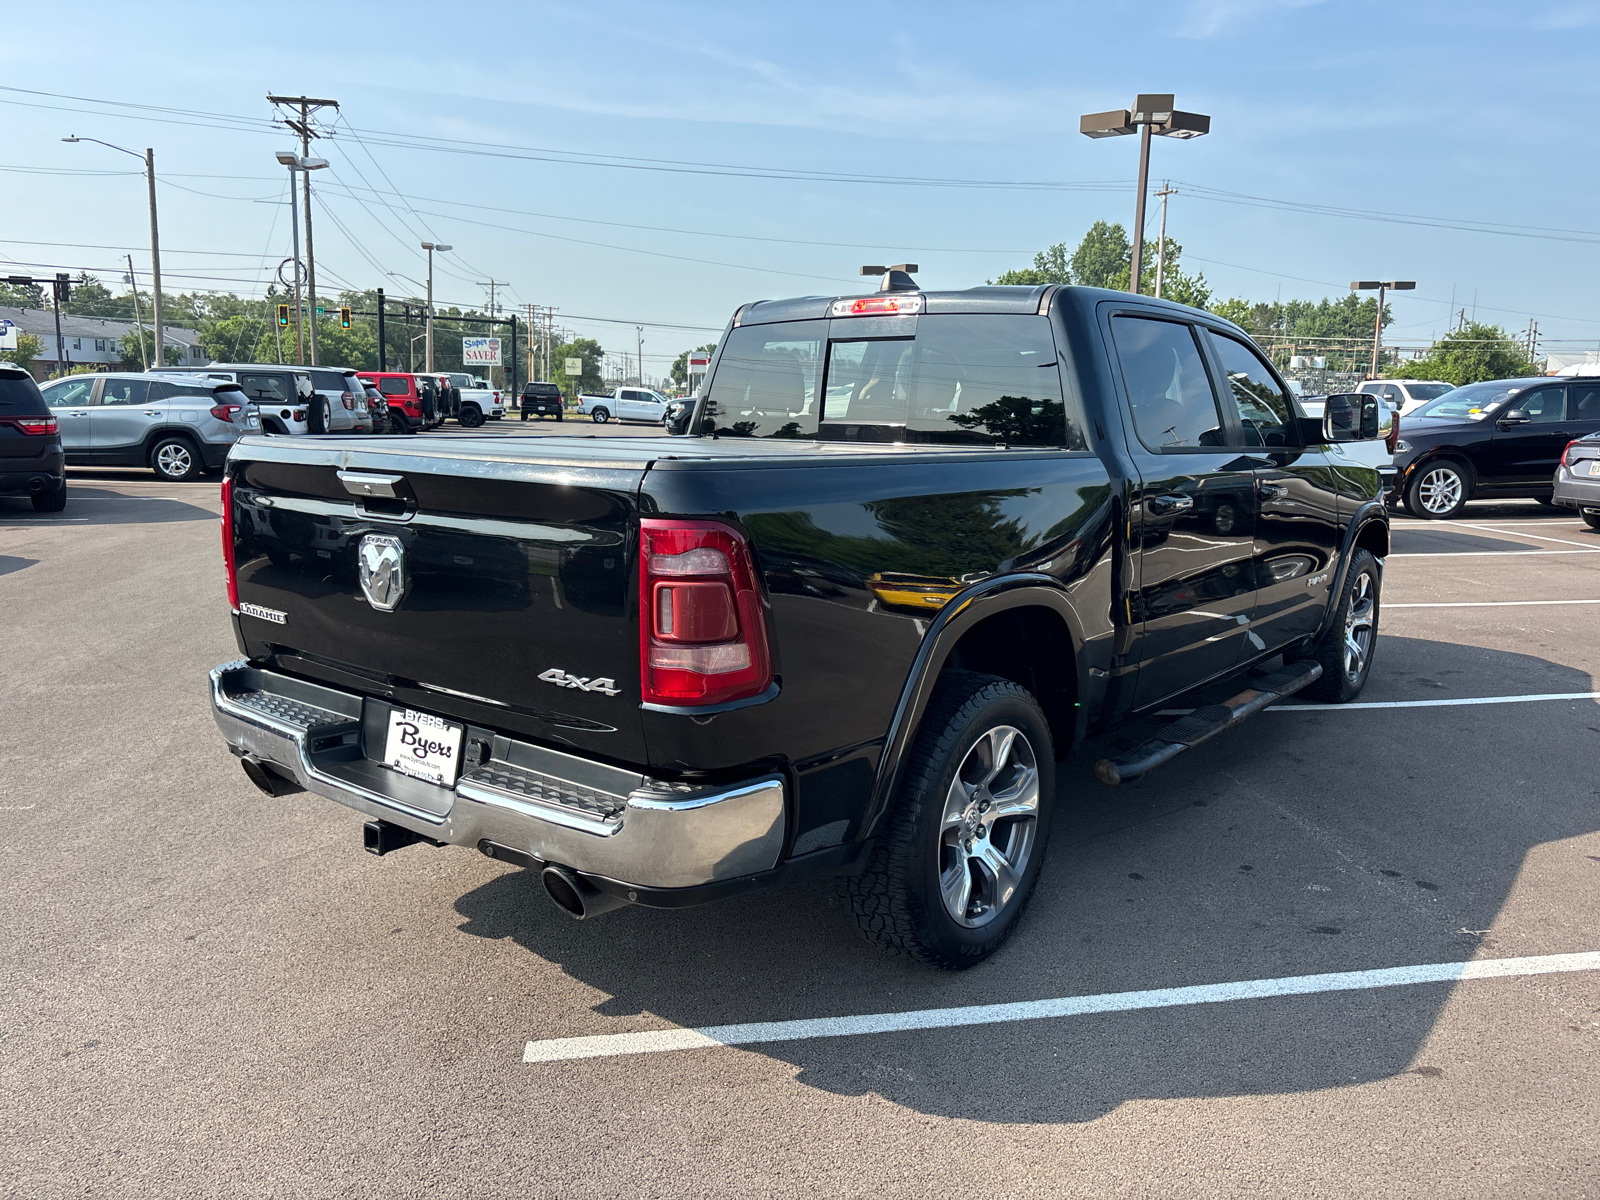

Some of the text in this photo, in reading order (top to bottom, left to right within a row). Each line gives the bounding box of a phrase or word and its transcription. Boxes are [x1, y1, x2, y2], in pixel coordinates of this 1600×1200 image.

[464, 339, 487, 348] Super
[466, 350, 496, 361] SAVER
[405, 708, 444, 730] BYERS
[395, 721, 452, 759] Byers
